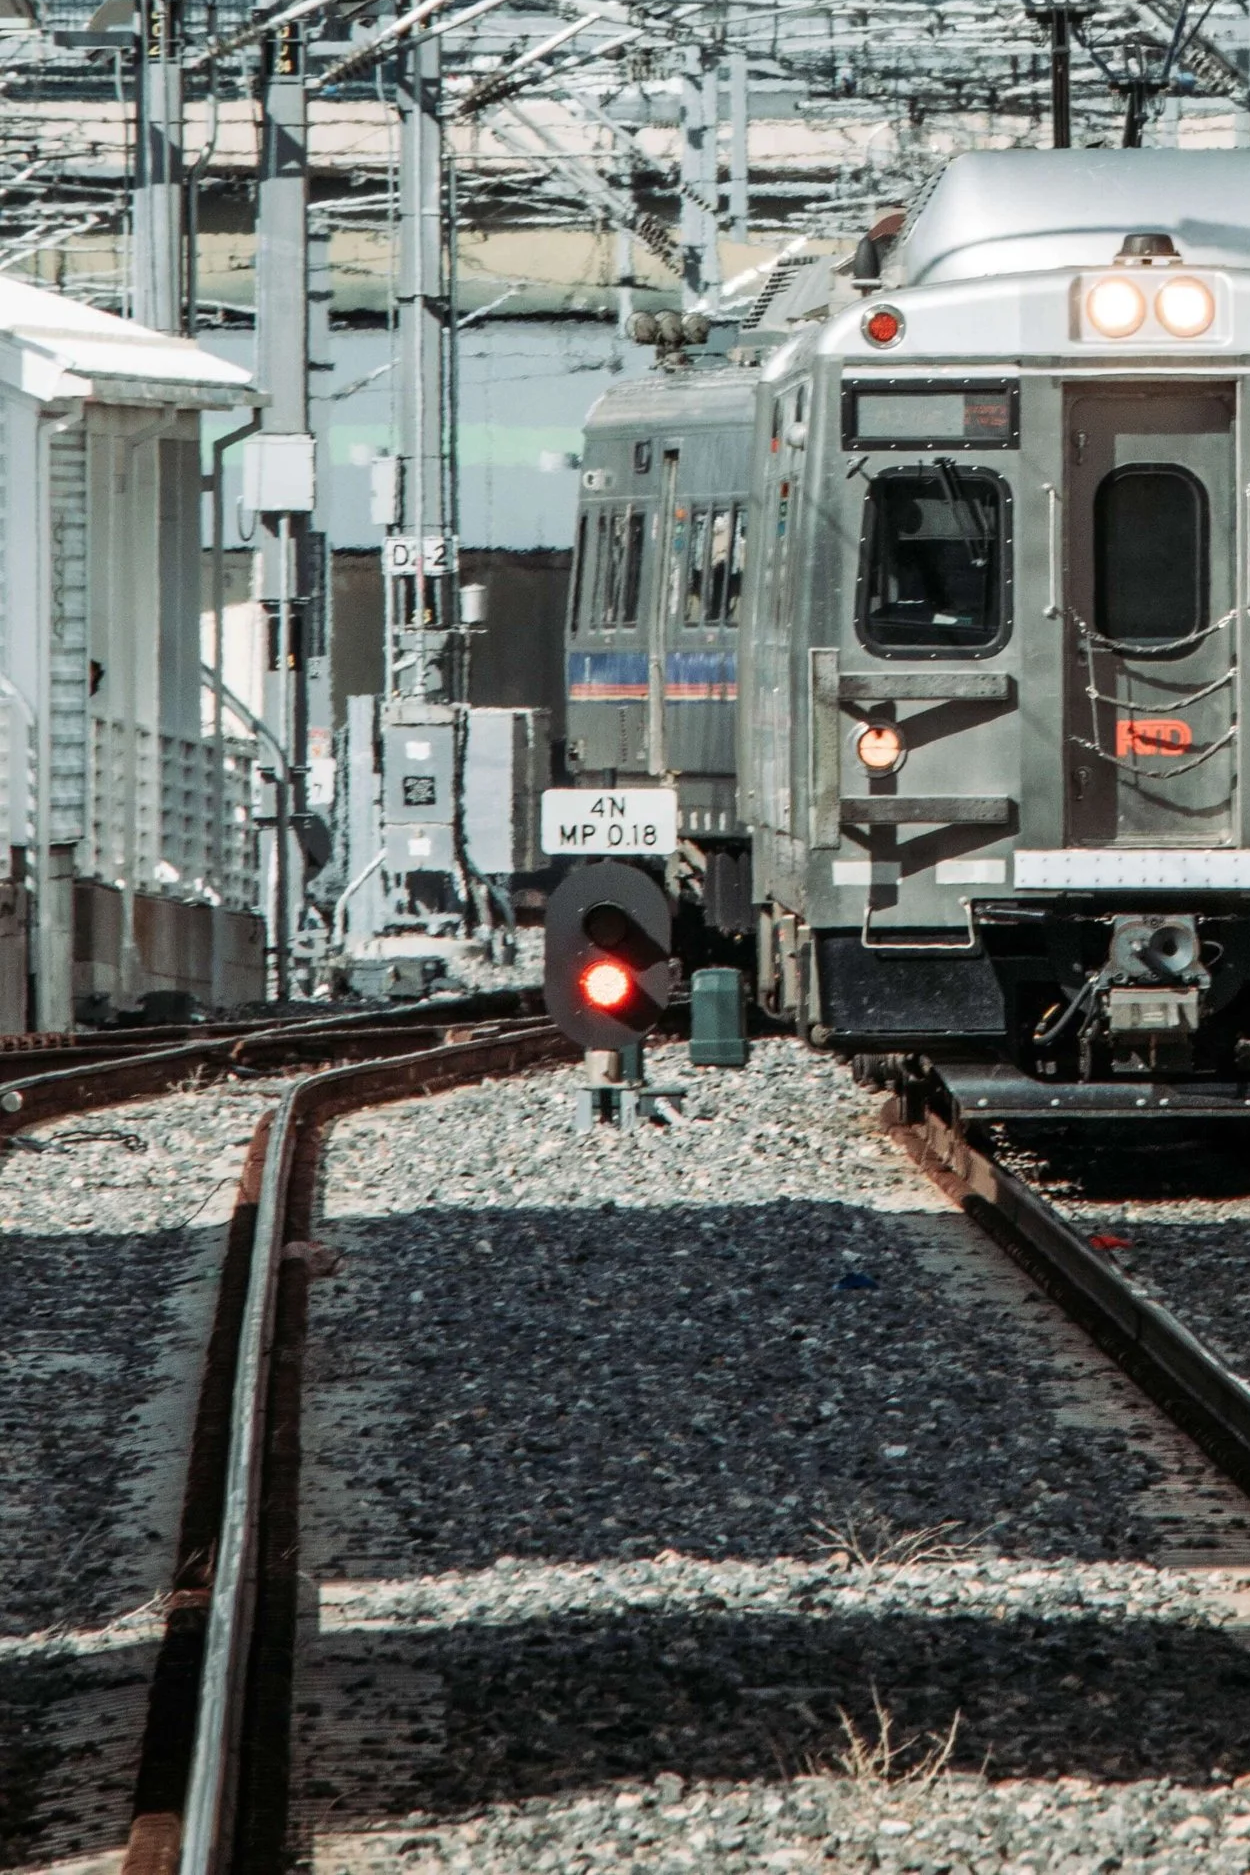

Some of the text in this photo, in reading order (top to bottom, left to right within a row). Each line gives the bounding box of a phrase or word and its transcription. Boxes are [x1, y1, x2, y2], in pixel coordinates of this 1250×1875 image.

[590, 797, 626, 818] 4N
[559, 824, 657, 846] MP 0.18
